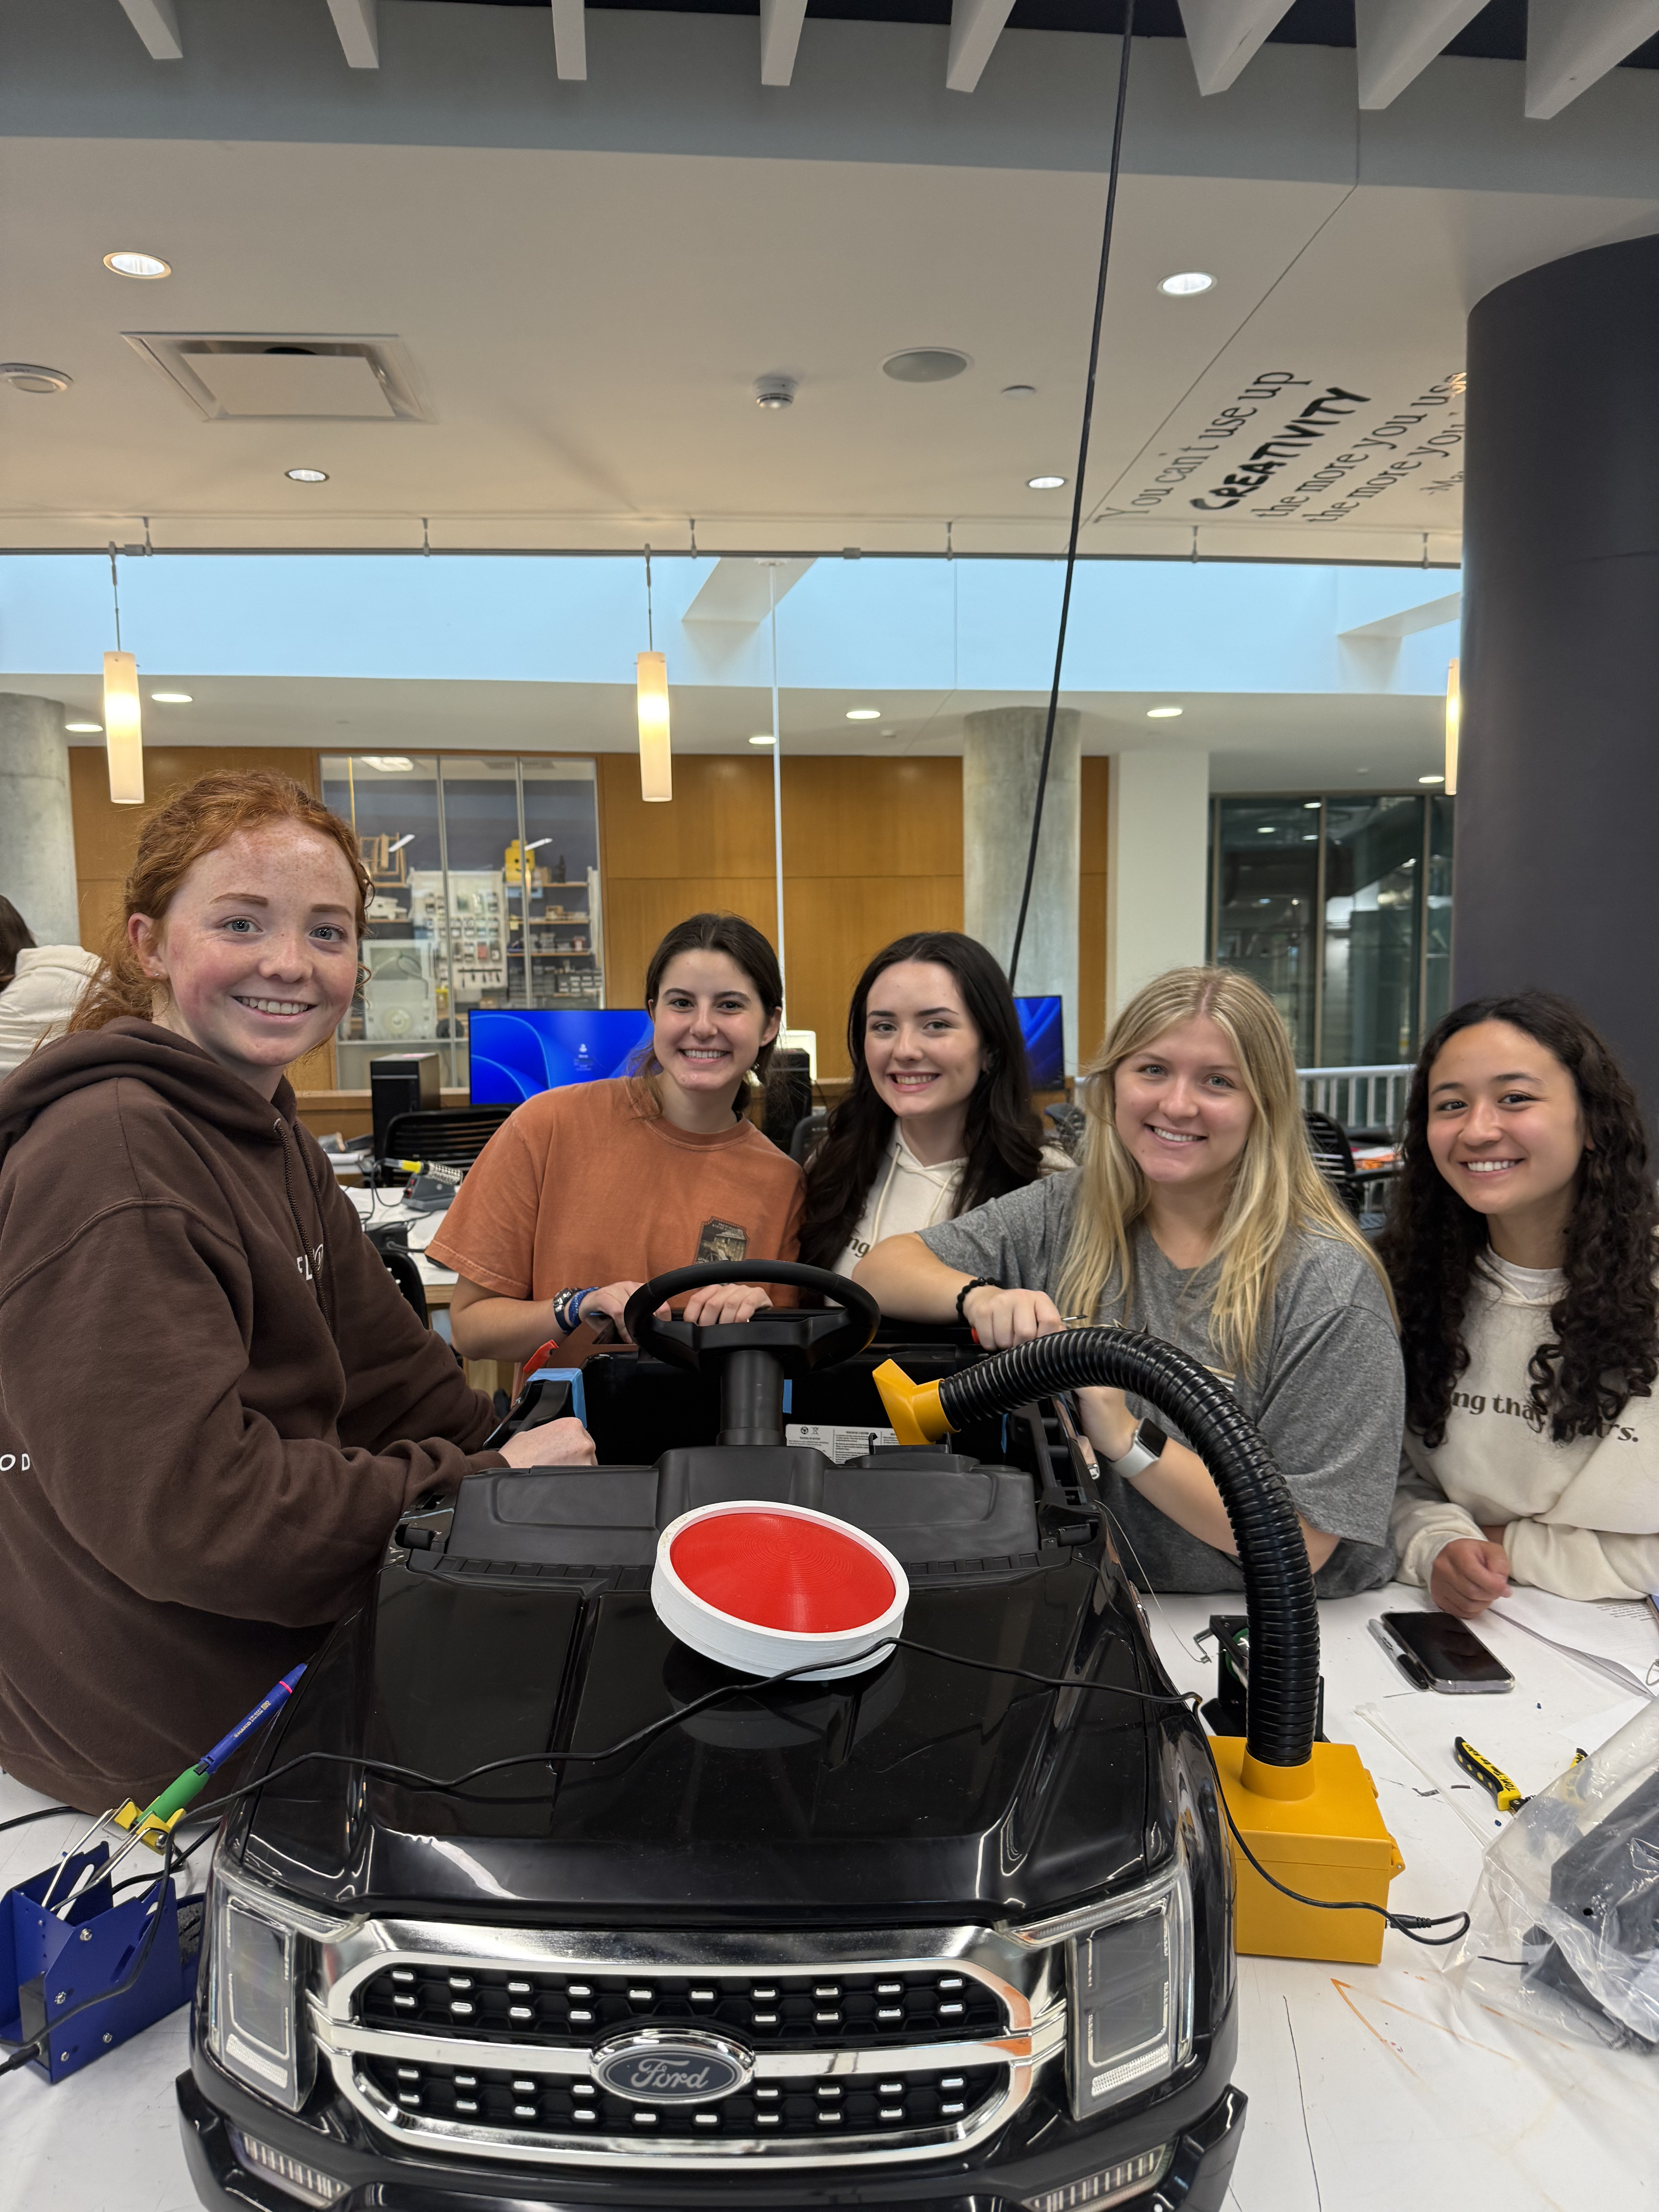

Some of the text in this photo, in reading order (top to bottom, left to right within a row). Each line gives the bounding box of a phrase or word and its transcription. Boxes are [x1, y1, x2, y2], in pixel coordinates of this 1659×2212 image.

[1093, 371, 1313, 524] You can't use up
[1190, 386, 1371, 510] CREATIVITY
[1250, 495, 1310, 517] the
[1295, 453, 1369, 493] more
[1351, 413, 1428, 450] you
[1302, 501, 1361, 522] the
[1346, 461, 1423, 498] more
[630, 2057, 711, 2088] Ford
